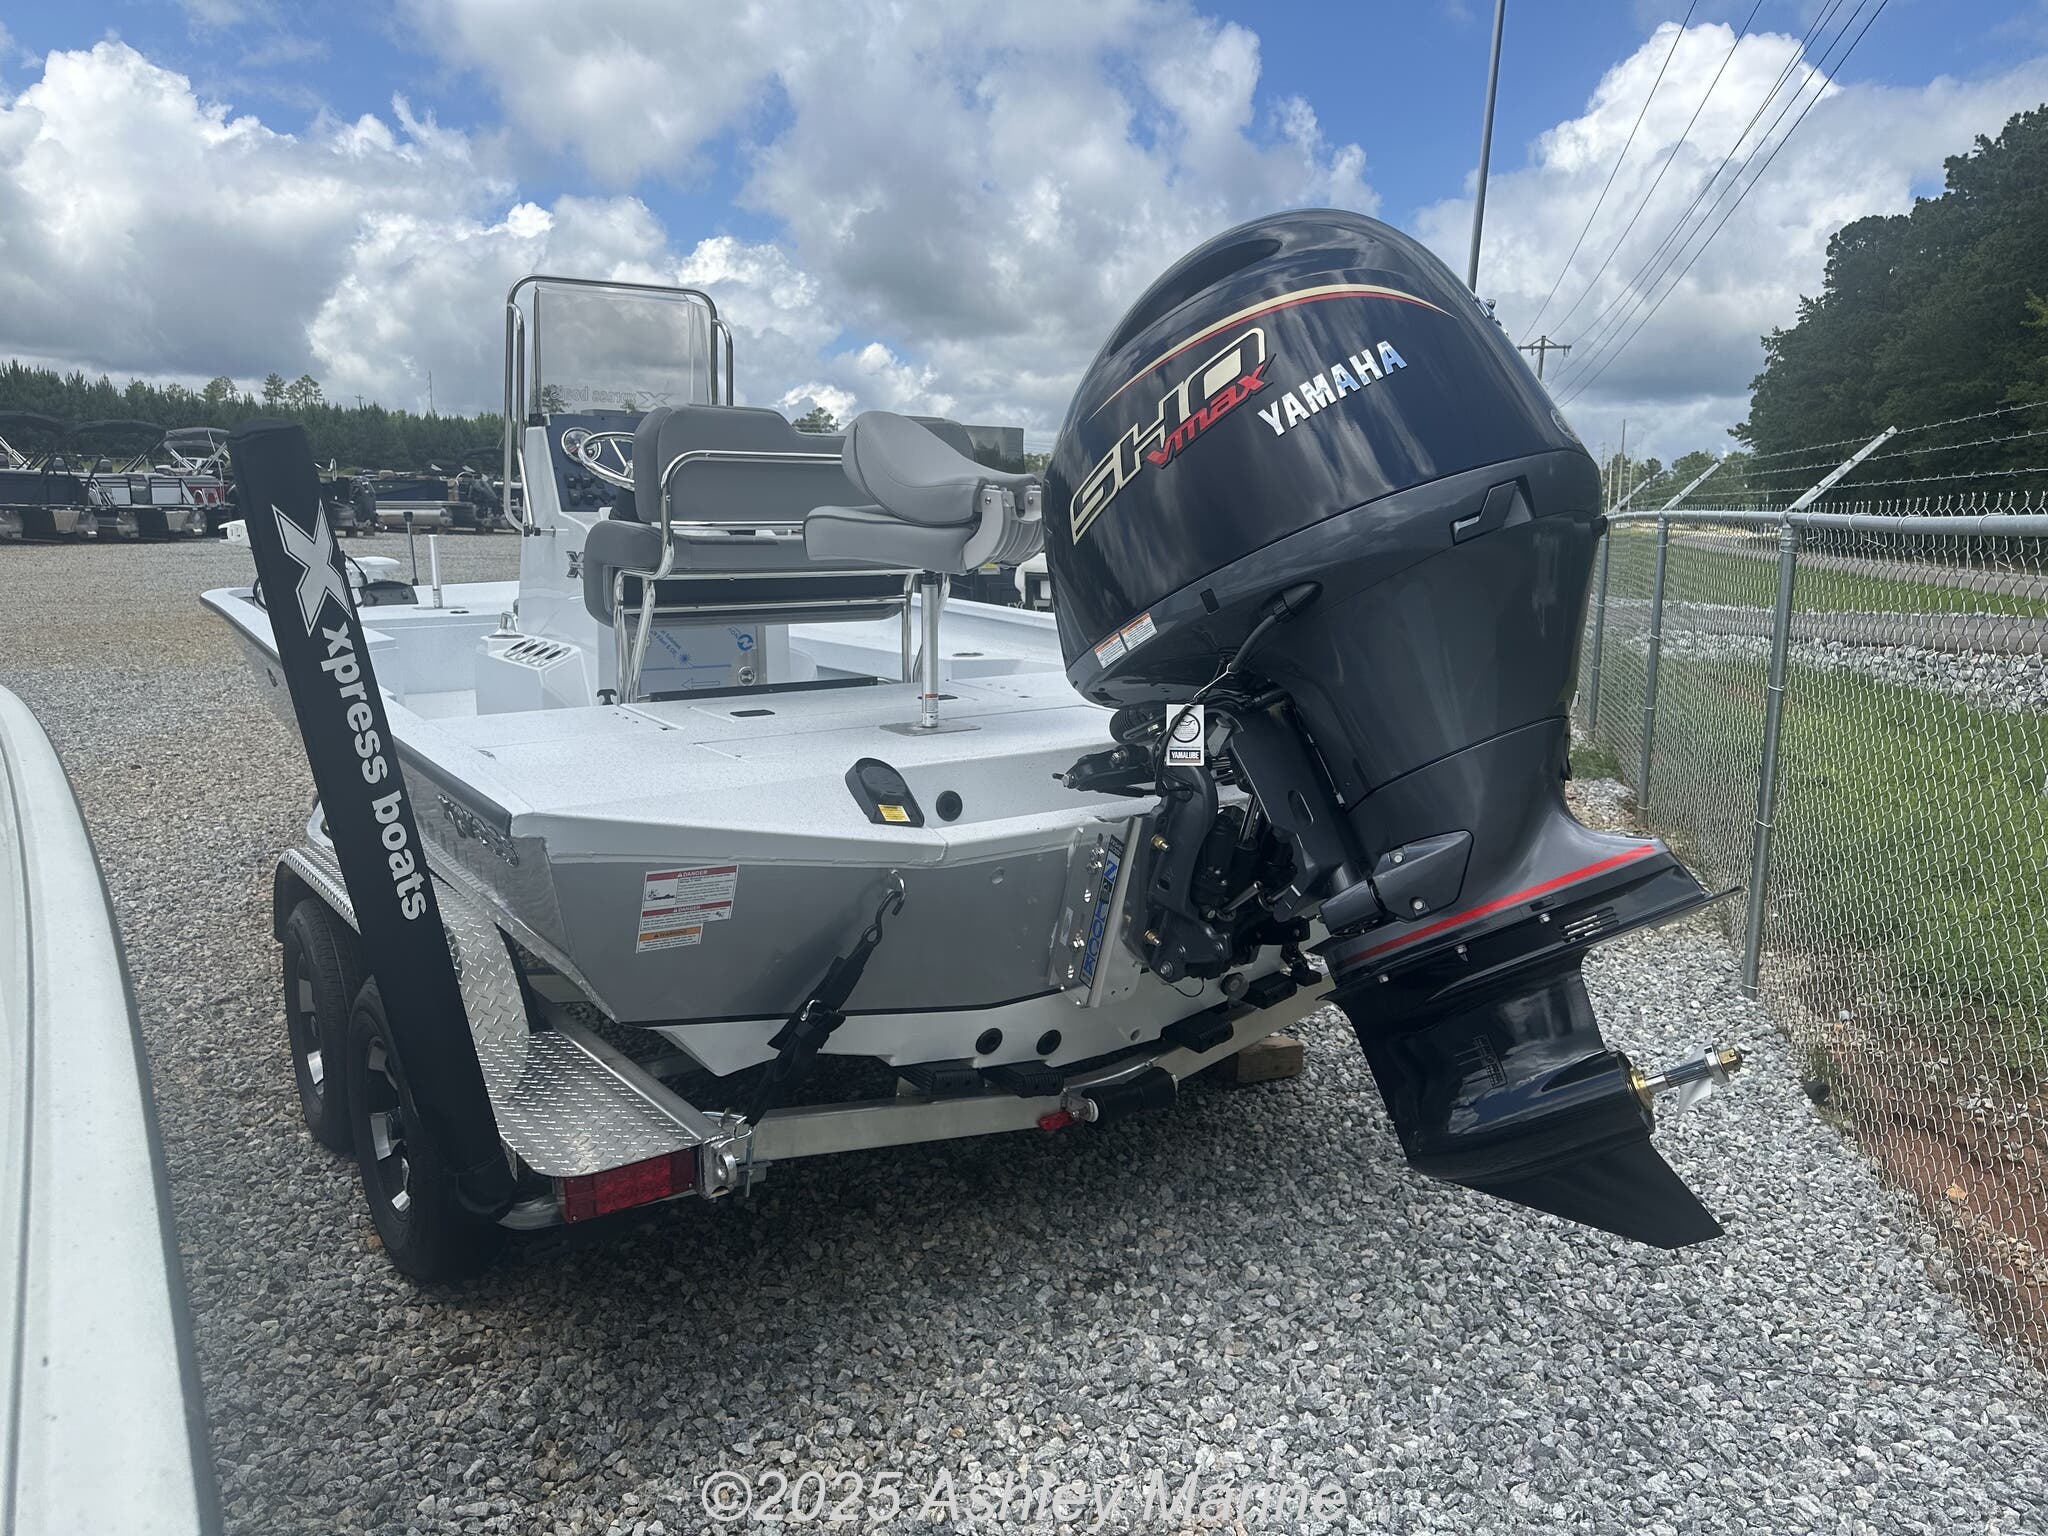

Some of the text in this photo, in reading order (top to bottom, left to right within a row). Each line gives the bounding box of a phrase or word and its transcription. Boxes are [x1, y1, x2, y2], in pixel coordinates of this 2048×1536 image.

[1257, 340, 1408, 437] YAMAHA
[320, 621, 388, 785] xpress
[372, 790, 428, 921] boats
[1171, 751, 1200, 759] YAMALUBE
